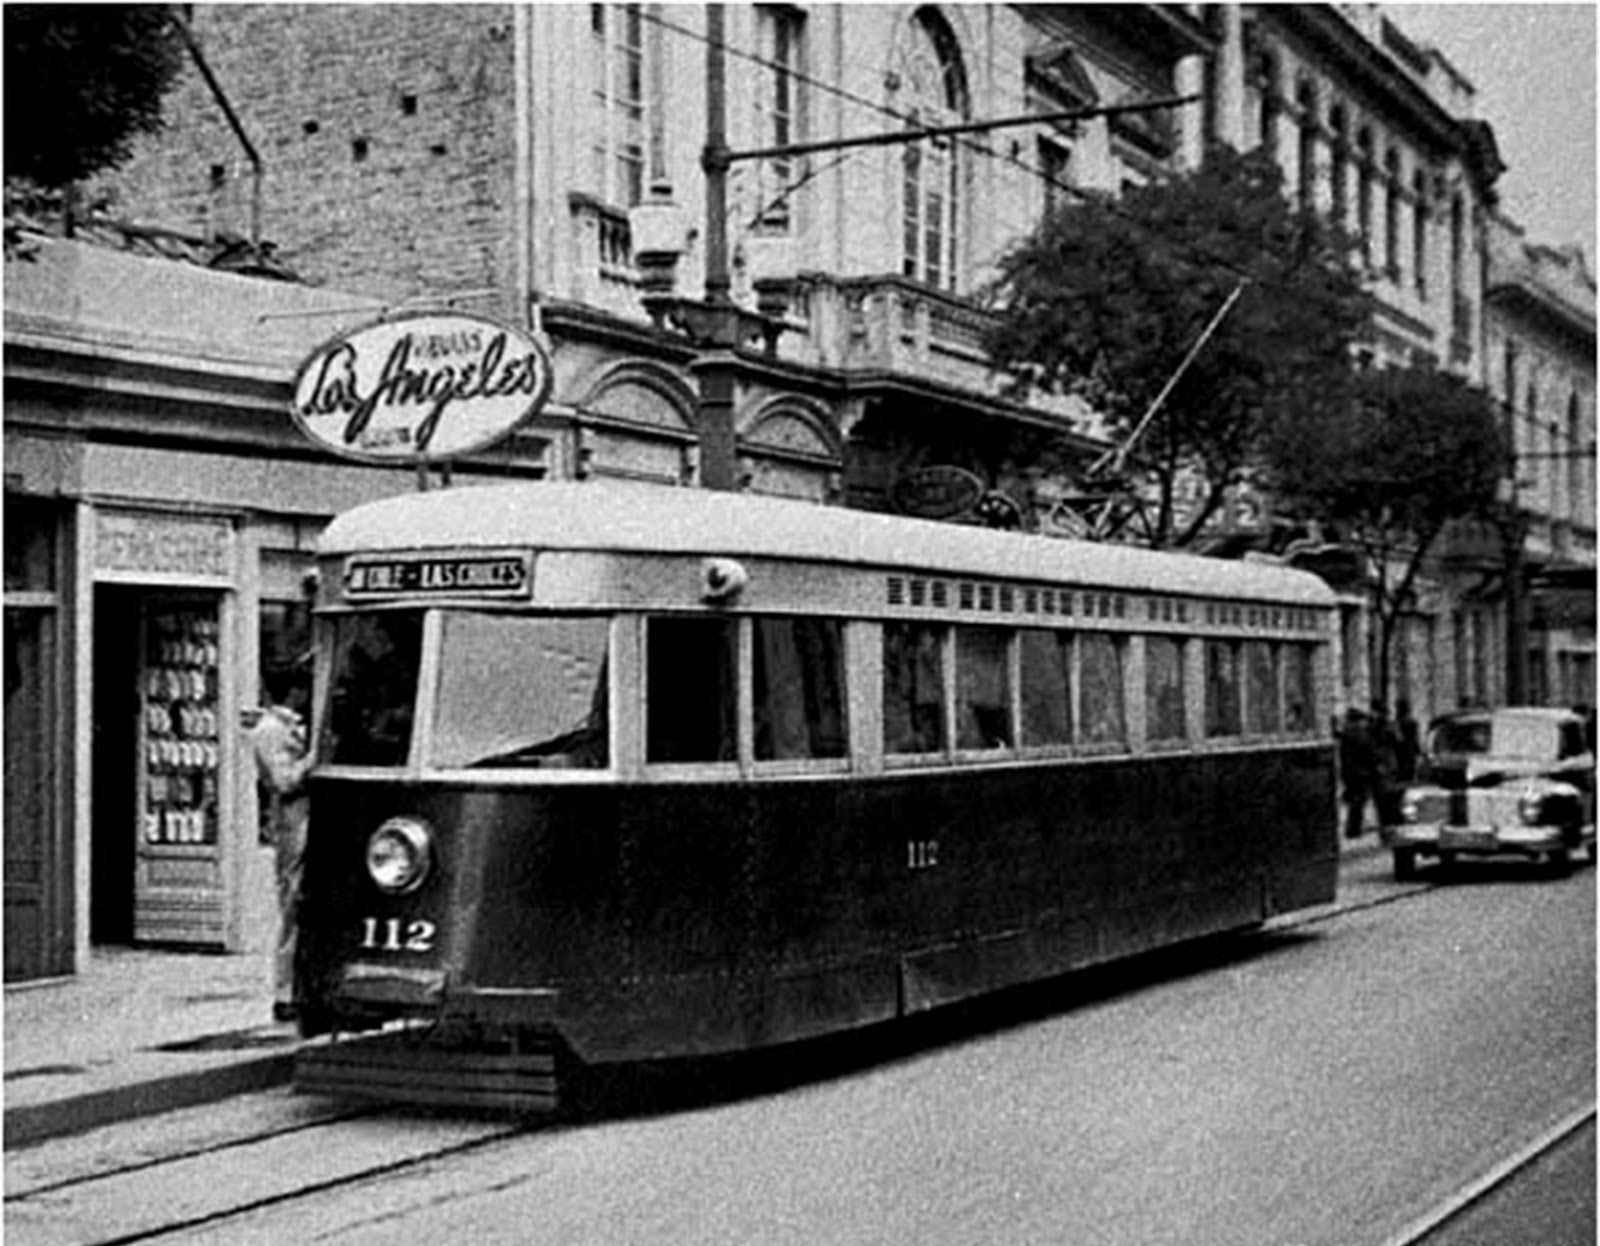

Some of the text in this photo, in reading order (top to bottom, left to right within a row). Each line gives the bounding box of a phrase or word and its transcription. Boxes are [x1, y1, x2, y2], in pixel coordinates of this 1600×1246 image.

[303, 332, 536, 451] Los Angeles
[420, 563, 455, 588] LAS
[907, 841, 939, 868] 112
[360, 917, 436, 951] 112
